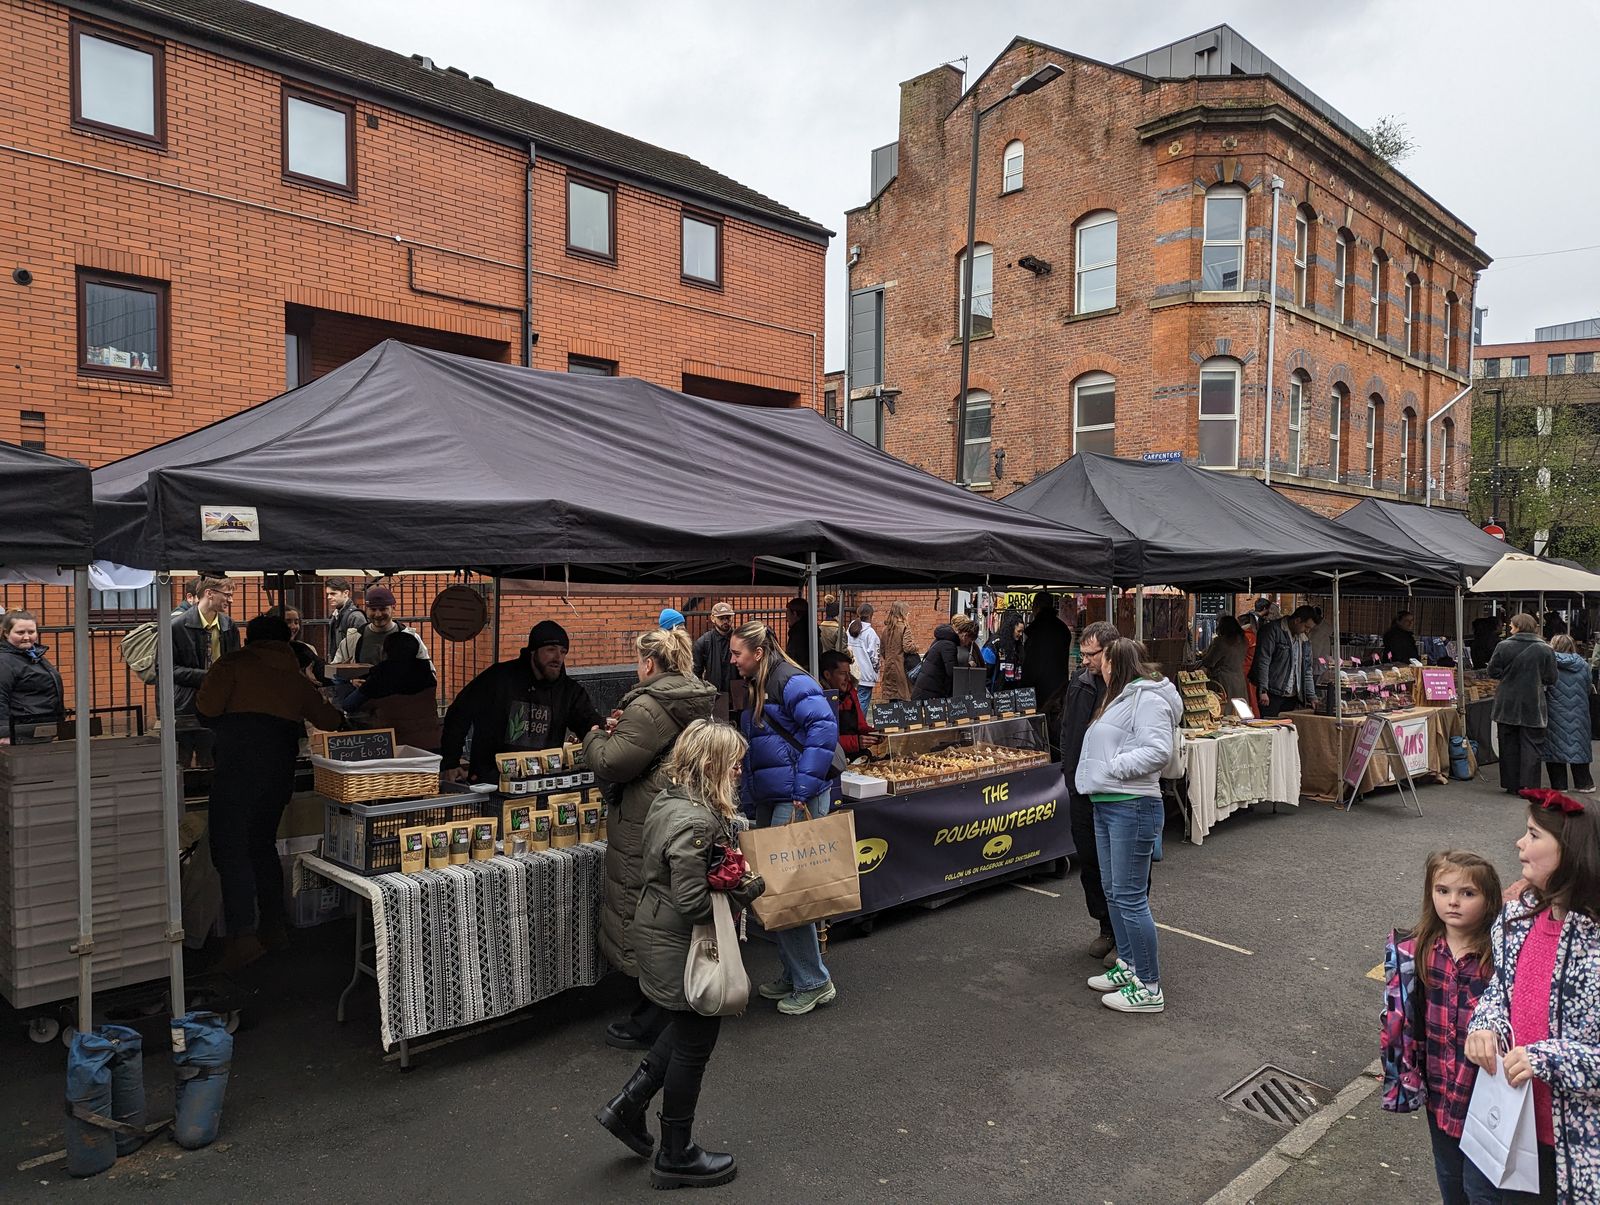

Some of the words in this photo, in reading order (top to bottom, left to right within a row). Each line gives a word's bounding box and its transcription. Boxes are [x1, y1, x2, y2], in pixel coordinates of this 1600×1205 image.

[1008, 594, 1033, 604] DARK
[982, 782, 1009, 805] THE
[933, 800, 1057, 847] DOUGHNUTEERS!
[769, 841, 838, 865] PRIMARK
[944, 870, 965, 882] FOLLOW
[979, 860, 1005, 872] FACEBOOK
